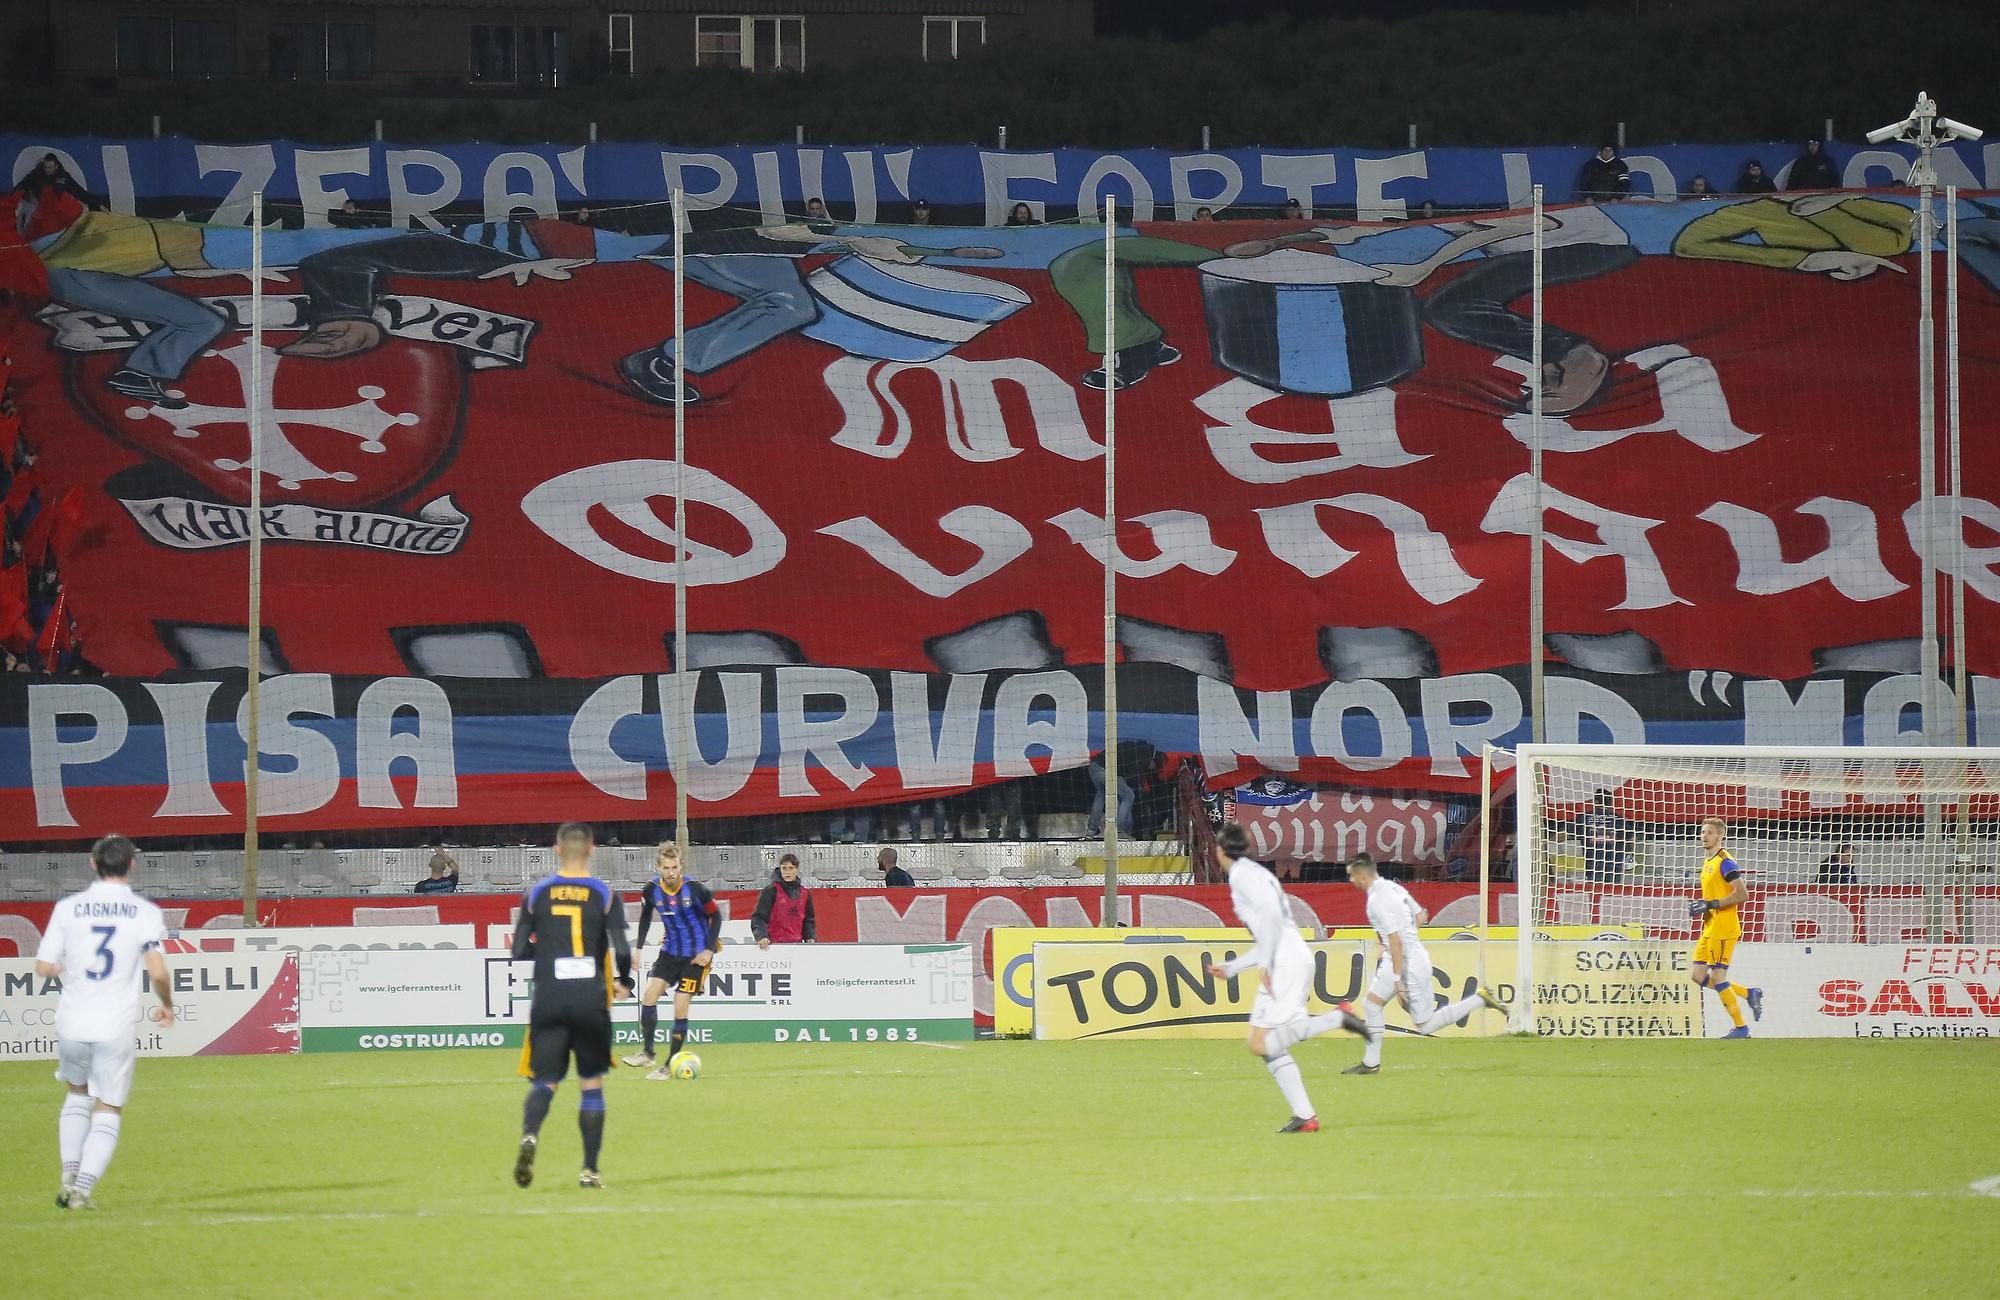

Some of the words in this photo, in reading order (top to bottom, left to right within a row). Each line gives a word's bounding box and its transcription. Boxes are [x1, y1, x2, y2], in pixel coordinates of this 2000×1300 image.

[28, 673, 458, 827] PISA
[568, 667, 1088, 801] CURVA
[1197, 673, 1645, 804] NORD
[74, 903, 137, 919] CAGNANO
[551, 904, 584, 957] 7
[86, 926, 116, 981] 3
[1575, 950, 1661, 972] SCAVI
[1672, 951, 1688, 972] E
[359, 984, 462, 993] www.igcferrantesrl.it
[680, 978, 697, 993] 30
[1047, 950, 1240, 1024] TONI
[1498, 983, 1689, 1004] DMOLIZIONI
[616, 1028, 713, 1043] PASINE
[775, 1028, 831, 1041] DAL
[850, 1027, 918, 1041] 1983
[1507, 1015, 1691, 1037] DUSTRIALI
[359, 1032, 504, 1048] COSTRUIAMO
